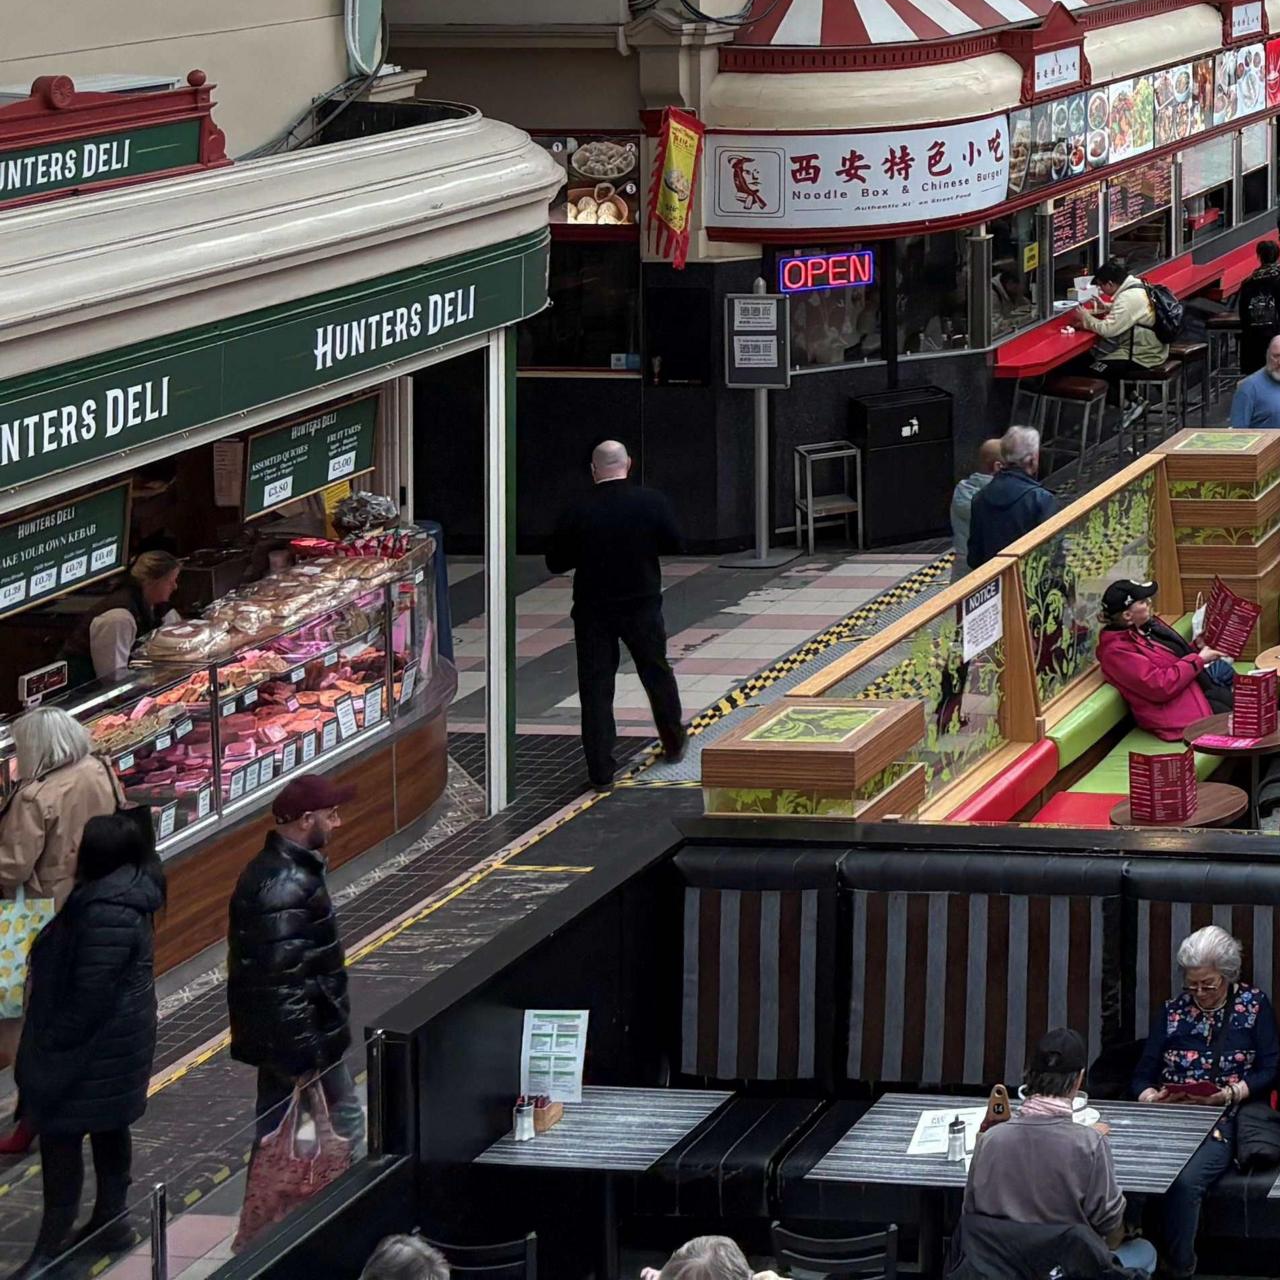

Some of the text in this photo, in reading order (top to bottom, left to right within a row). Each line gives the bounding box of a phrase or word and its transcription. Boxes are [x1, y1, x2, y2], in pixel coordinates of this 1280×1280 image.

[82, 139, 131, 179] DELI
[790, 128, 1004, 185] 西安特色小吃
[792, 169, 1003, 201] Noodle Box & Chinese Burger
[783, 254, 869, 289] OPEN
[314, 285, 476, 371] HUNTERS DELI
[105, 375, 171, 439] DELI
[291, 412, 337, 440] HUNTERS DELI
[252, 451, 282, 471] ASSORTED
[332, 456, 352, 472] £3.00
[18, 506, 75, 540] HUNTERS DELI
[20, 543, 45, 562] YOUR
[45, 535, 67, 552] OWN
[67, 524, 97, 544] KEBAB
[969, 581, 996, 611] NOTICE
